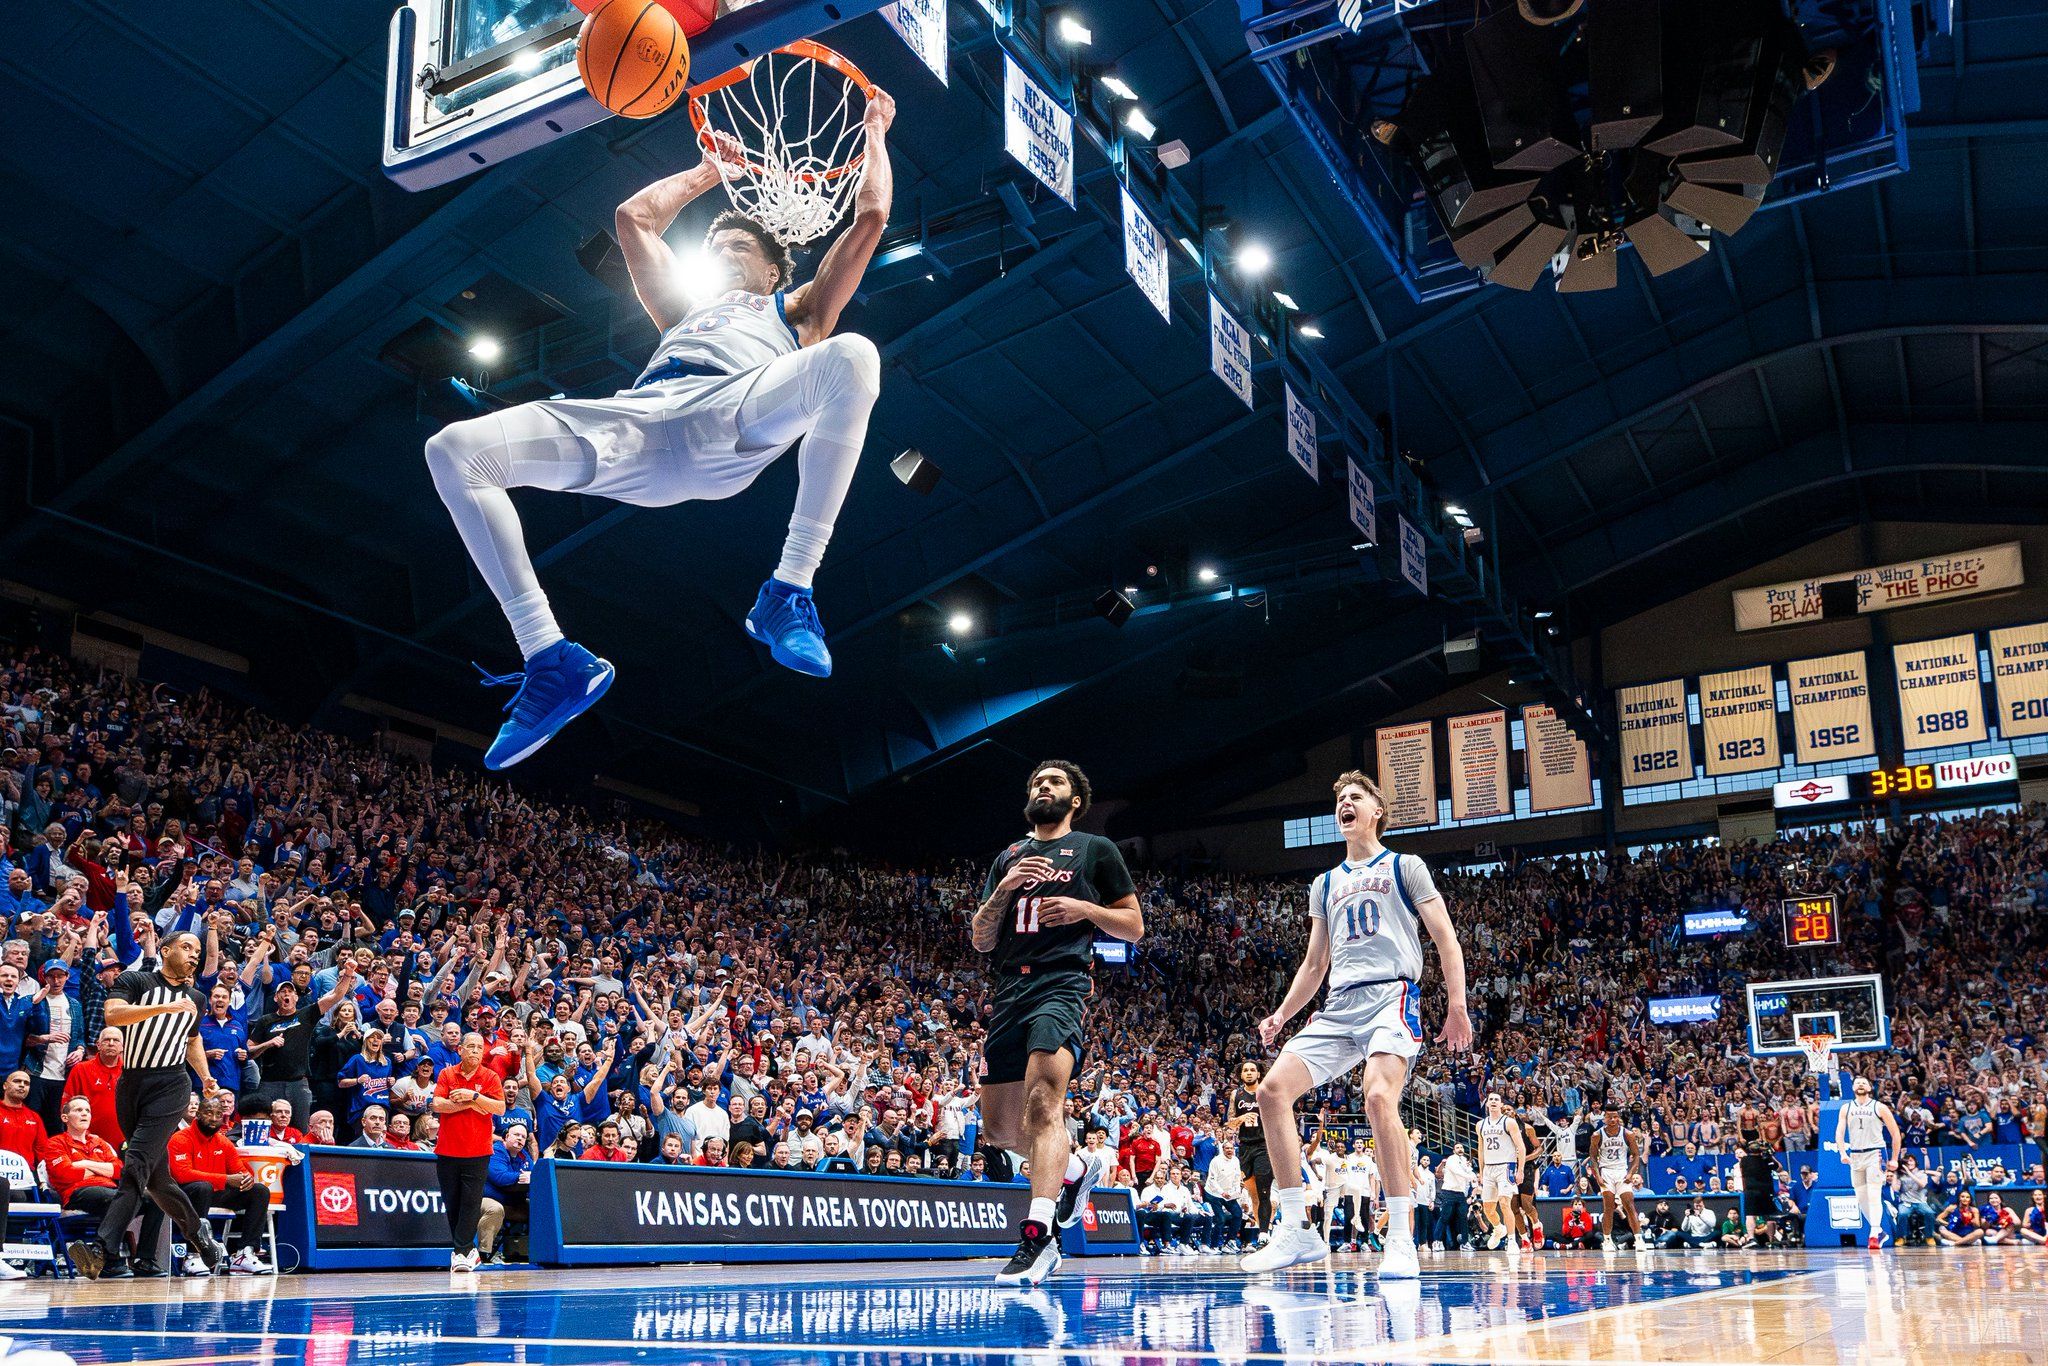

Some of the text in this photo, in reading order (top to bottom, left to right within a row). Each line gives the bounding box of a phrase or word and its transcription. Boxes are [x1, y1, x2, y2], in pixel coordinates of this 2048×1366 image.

[1024, 82, 1056, 130] NCAA
[1012, 95, 1070, 163] FINAL FOUR
[1028, 139, 1057, 182] 1993
[1134, 210, 1156, 251] NCAA
[1876, 568, 1913, 583] Who
[1769, 597, 1823, 624] BEWAR
[1905, 653, 1968, 673] NATIONAL
[1799, 670, 1859, 688] NATIONAL
[1900, 669, 1977, 690] CHAMPIONS
[1709, 684, 1766, 702] NATIONAL
[1794, 685, 1867, 706] CHAMPIONS
[1625, 697, 1678, 715] NATIONAL
[1704, 699, 1773, 719] CHAMPIONS
[1452, 715, 1503, 729] ALL-AMERICANS
[1620, 711, 1685, 731] CHAMPIONS
[1916, 709, 1969, 735] 1988
[1380, 728, 1430, 741] ALL-AMERICANS
[1809, 724, 1860, 749] 1952
[1717, 737, 1766, 761] 1923
[1632, 749, 1679, 773] 1922
[1871, 765, 1934, 795] 3:36
[1478, 842, 1493, 855] 21
[1331, 877, 1392, 905] KANSAS
[1015, 896, 1042, 933] 11
[1798, 902, 1830, 915] 7:41
[1344, 898, 1381, 942] 10
[1794, 916, 1828, 941] 28
[1858, 1118, 1864, 1130] 1
[1486, 1137, 1500, 1150] 25
[1607, 1149, 1619, 1160] 24
[363, 1189, 446, 1214] TOYOT
[635, 1190, 1008, 1230] KANSAS CITY AREA TOYOTA DEALERS
[1096, 1210, 1131, 1225] TOYOTA
